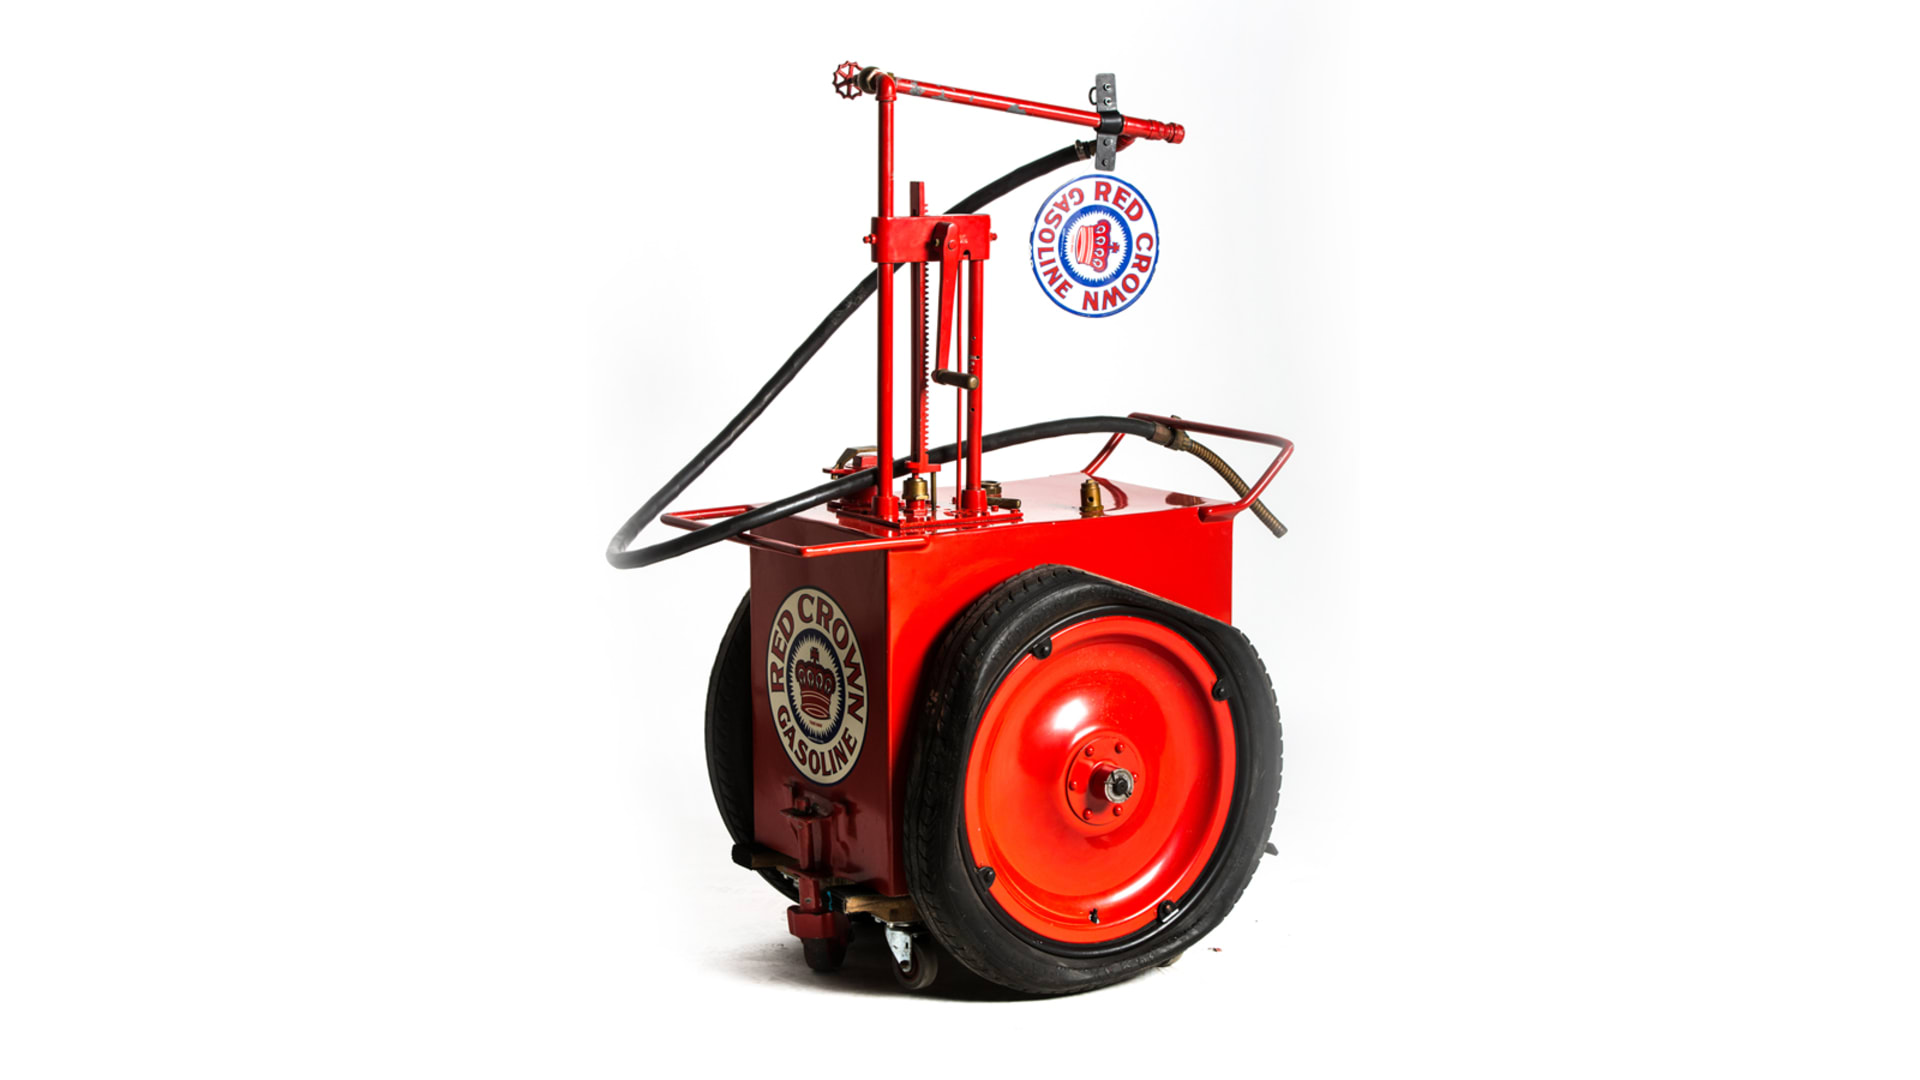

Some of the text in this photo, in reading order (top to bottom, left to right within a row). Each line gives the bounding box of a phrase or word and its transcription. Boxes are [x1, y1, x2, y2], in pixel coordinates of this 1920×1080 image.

[1038, 187, 1085, 299] GASOLINE
[1082, 181, 1154, 311] RED CROWN
[771, 593, 865, 724] RED CROWN
[777, 705, 858, 776] GASOLINE
